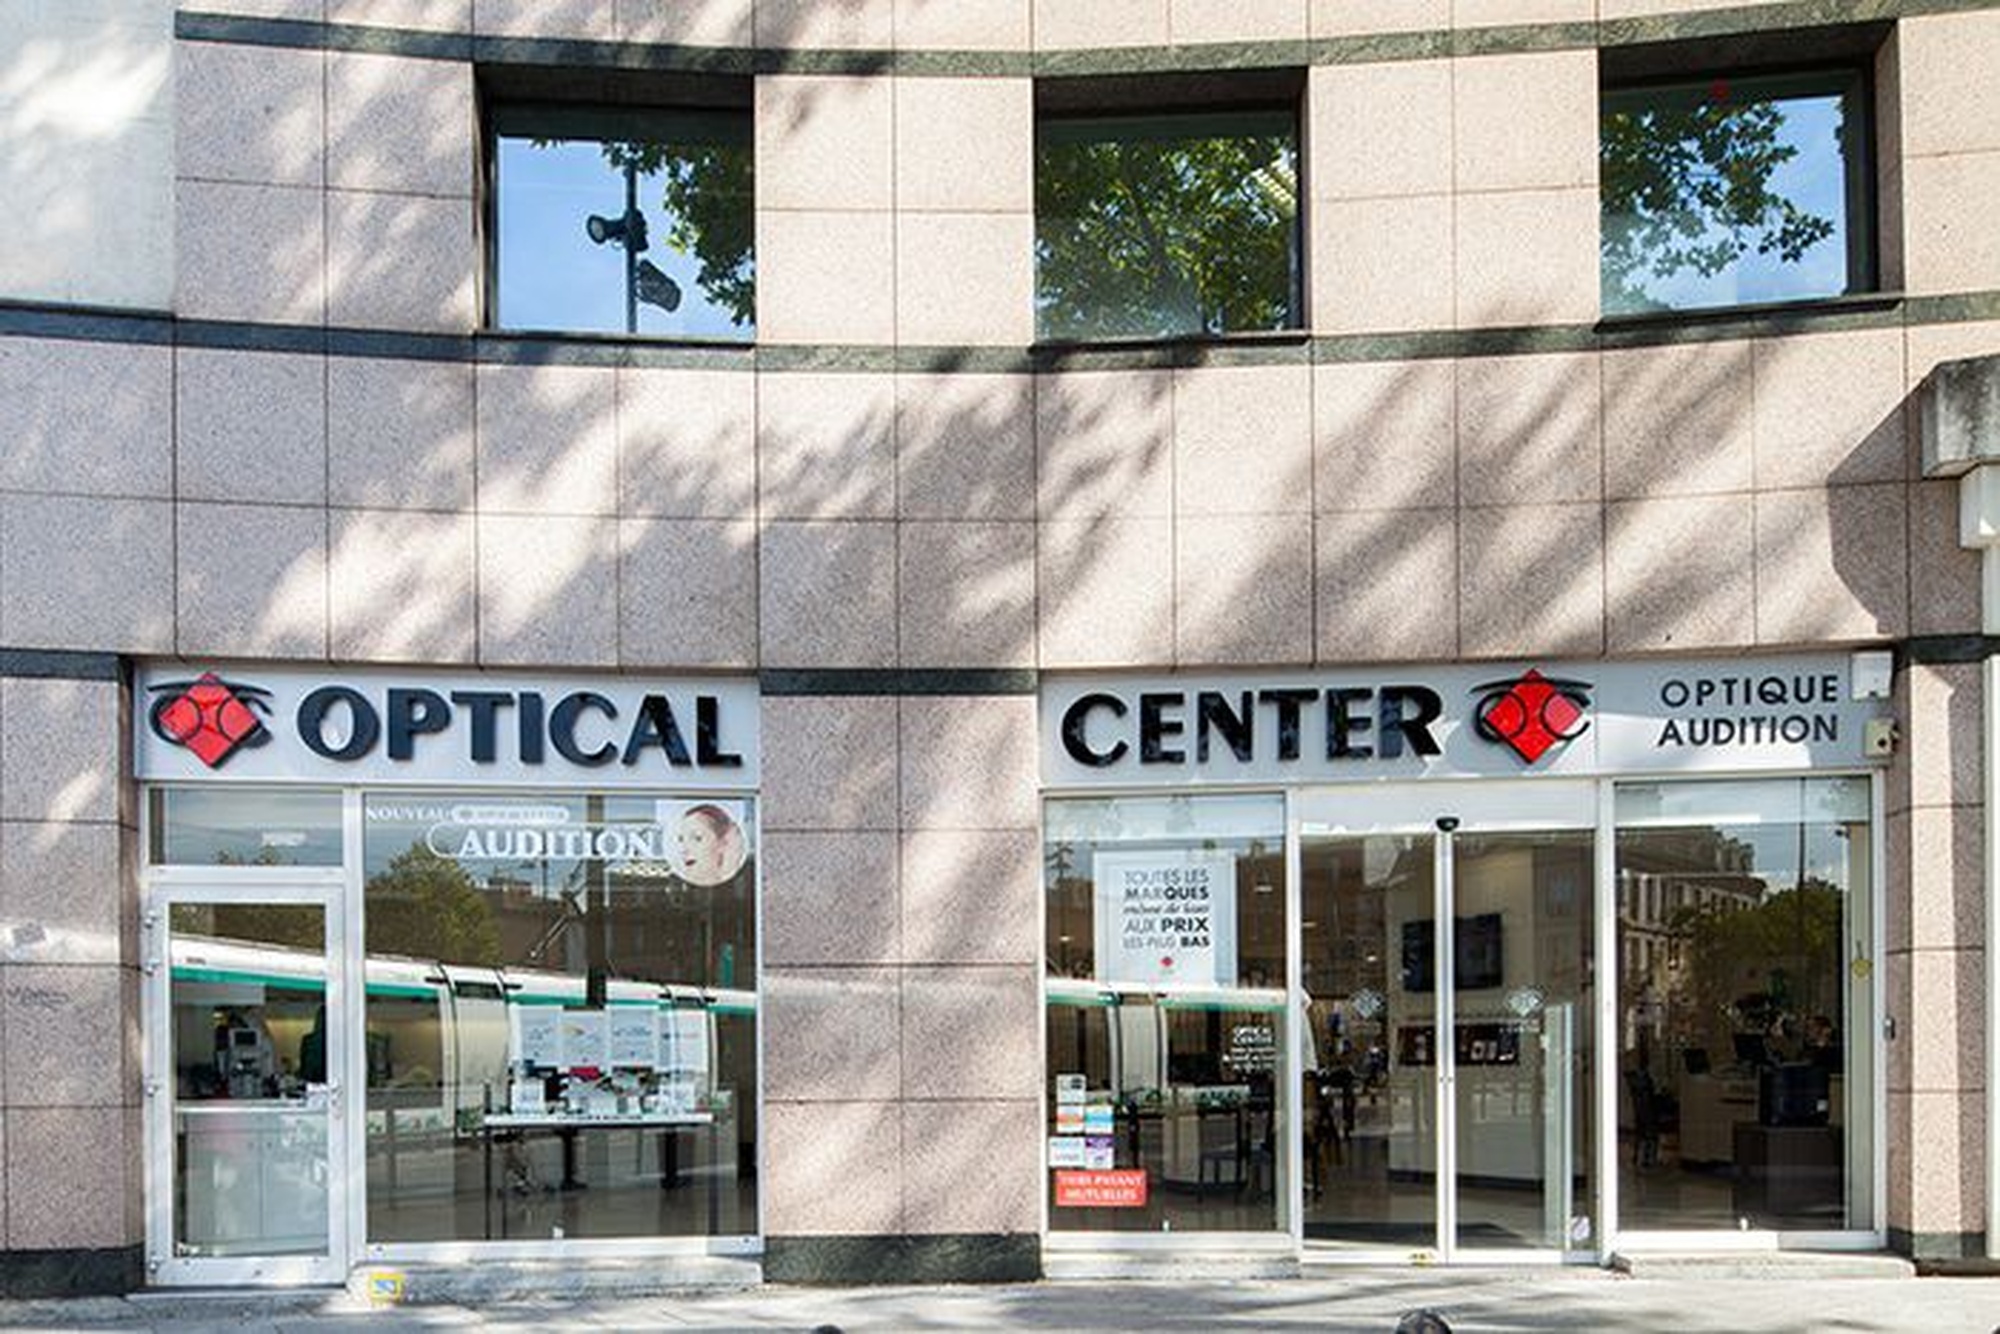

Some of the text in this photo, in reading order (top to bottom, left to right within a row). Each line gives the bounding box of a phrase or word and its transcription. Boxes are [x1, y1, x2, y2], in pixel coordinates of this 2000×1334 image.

[1661, 675, 1838, 708] OPTIQUE
[296, 685, 1443, 768] OPTICAL CENTER
[1658, 714, 1838, 747] AUDITION
[457, 825, 654, 858] AUDITION
[1124, 868, 1209, 885] TOUTES LES
[1123, 885, 1209, 901] MARQUES
[1124, 916, 1209, 935] AUX PRIX
[1181, 936, 1210, 948] BAS
